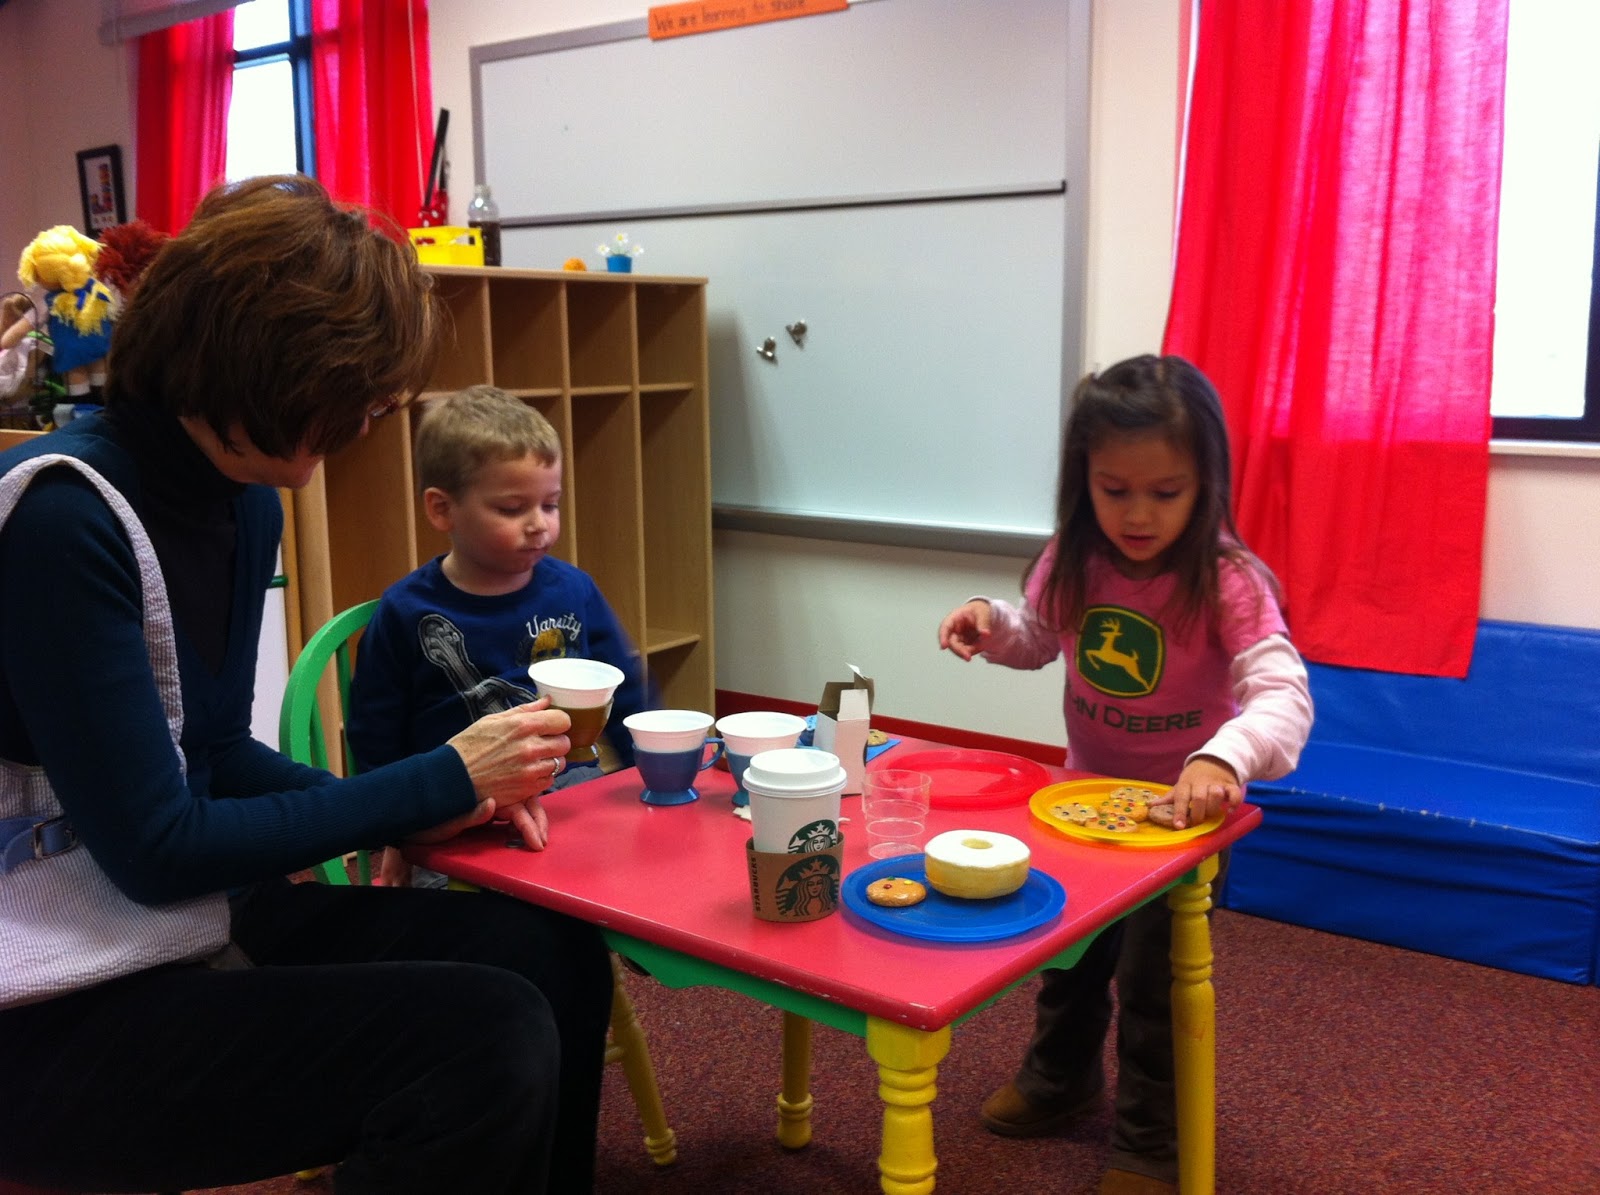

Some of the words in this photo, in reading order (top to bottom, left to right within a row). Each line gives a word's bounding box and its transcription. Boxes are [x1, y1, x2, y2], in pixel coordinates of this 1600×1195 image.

[654, 12, 674, 32] We
[679, 14, 697, 27] are
[702, 5, 746, 24] learning
[525, 612, 581, 641] Varsity
[1103, 704, 1203, 733] DEERE
[751, 857, 761, 912] STARBUCKS
